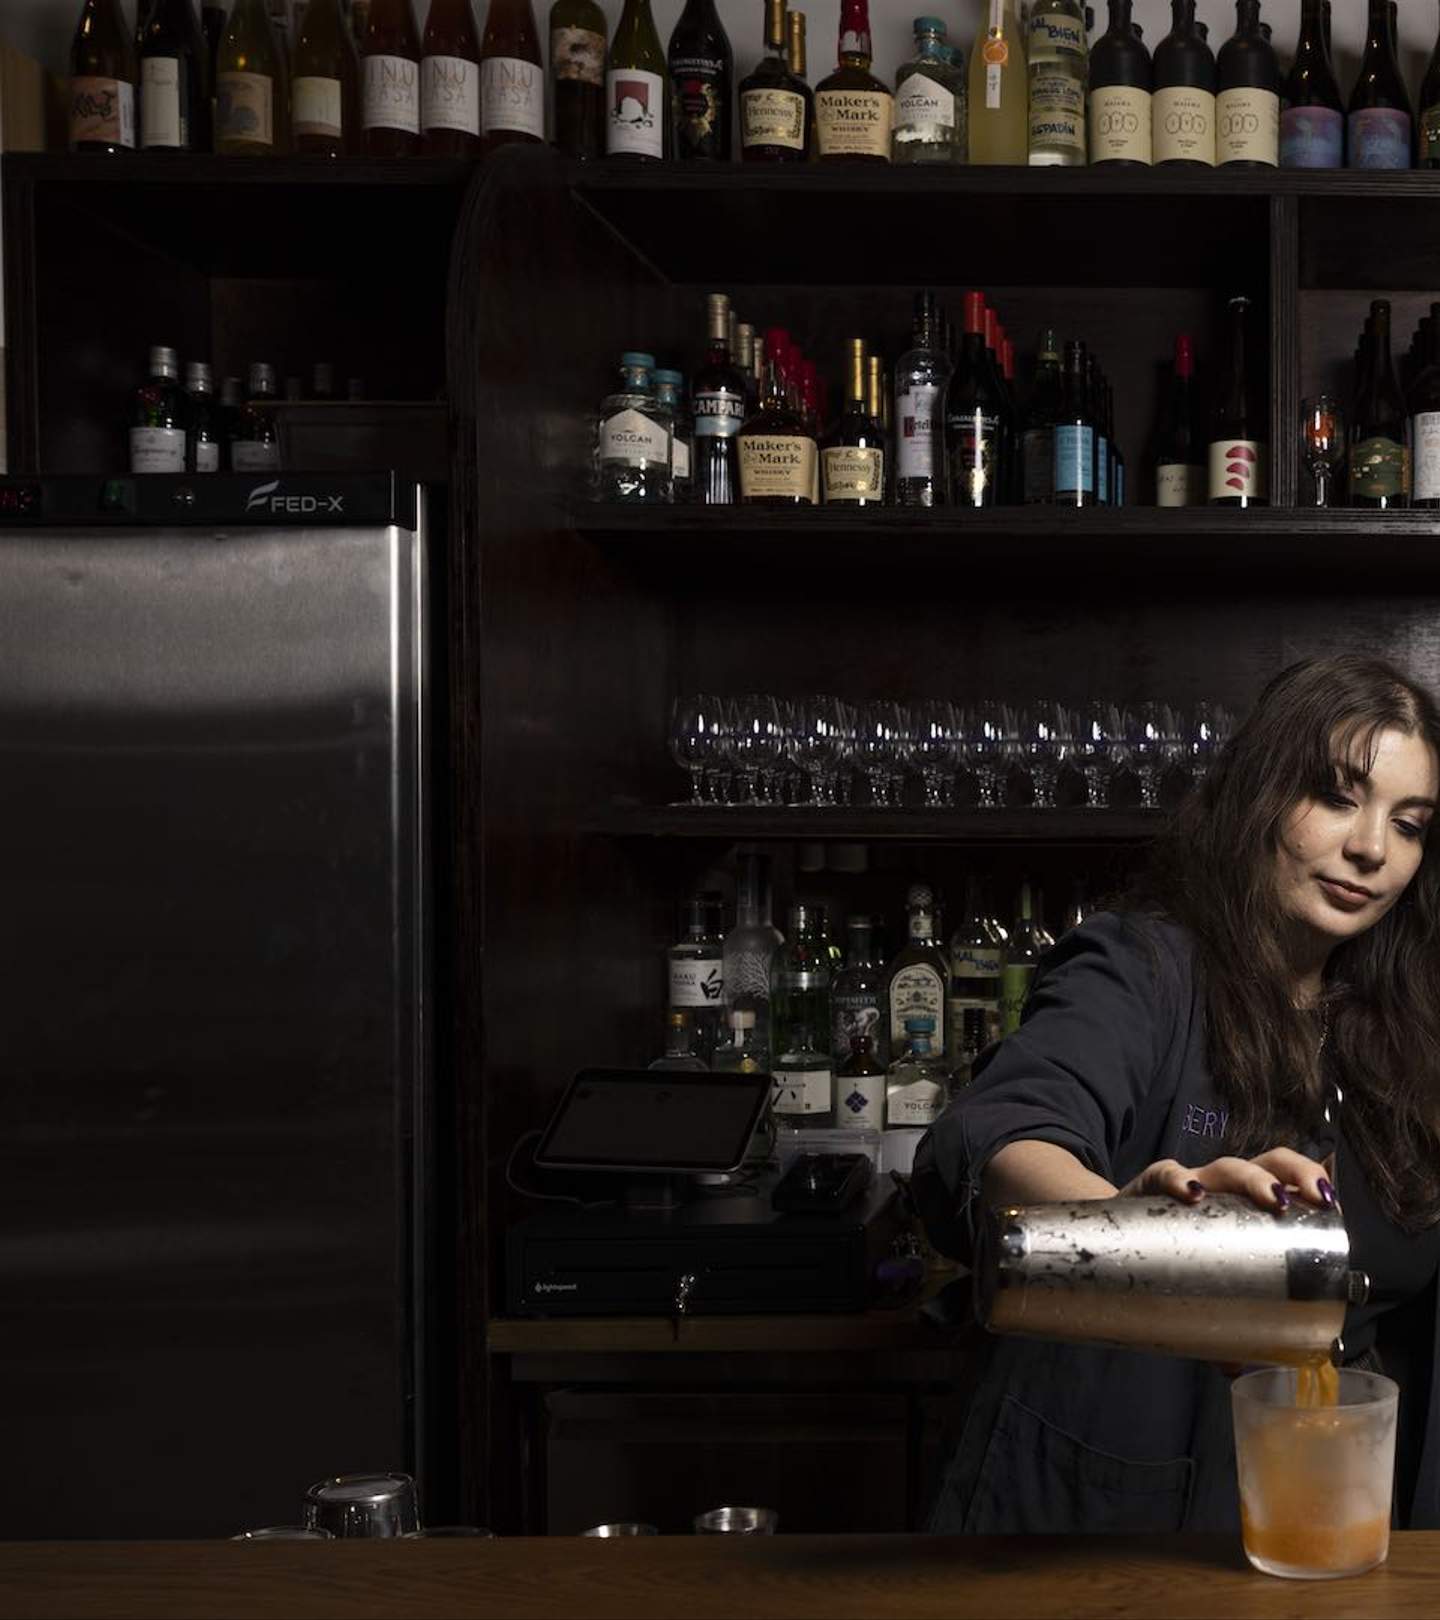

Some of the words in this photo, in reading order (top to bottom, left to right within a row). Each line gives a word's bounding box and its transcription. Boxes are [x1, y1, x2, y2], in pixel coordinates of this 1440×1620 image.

[820, 96, 881, 108] Maker's
[901, 98, 939, 108] VOLCAN
[836, 109, 880, 121] Mark
[611, 433, 653, 444] VOLCAN
[743, 440, 802, 453] Maker's
[758, 453, 802, 465] Mark
[829, 462, 872, 474] Hennessy
[271, 496, 344, 512] FED-X
